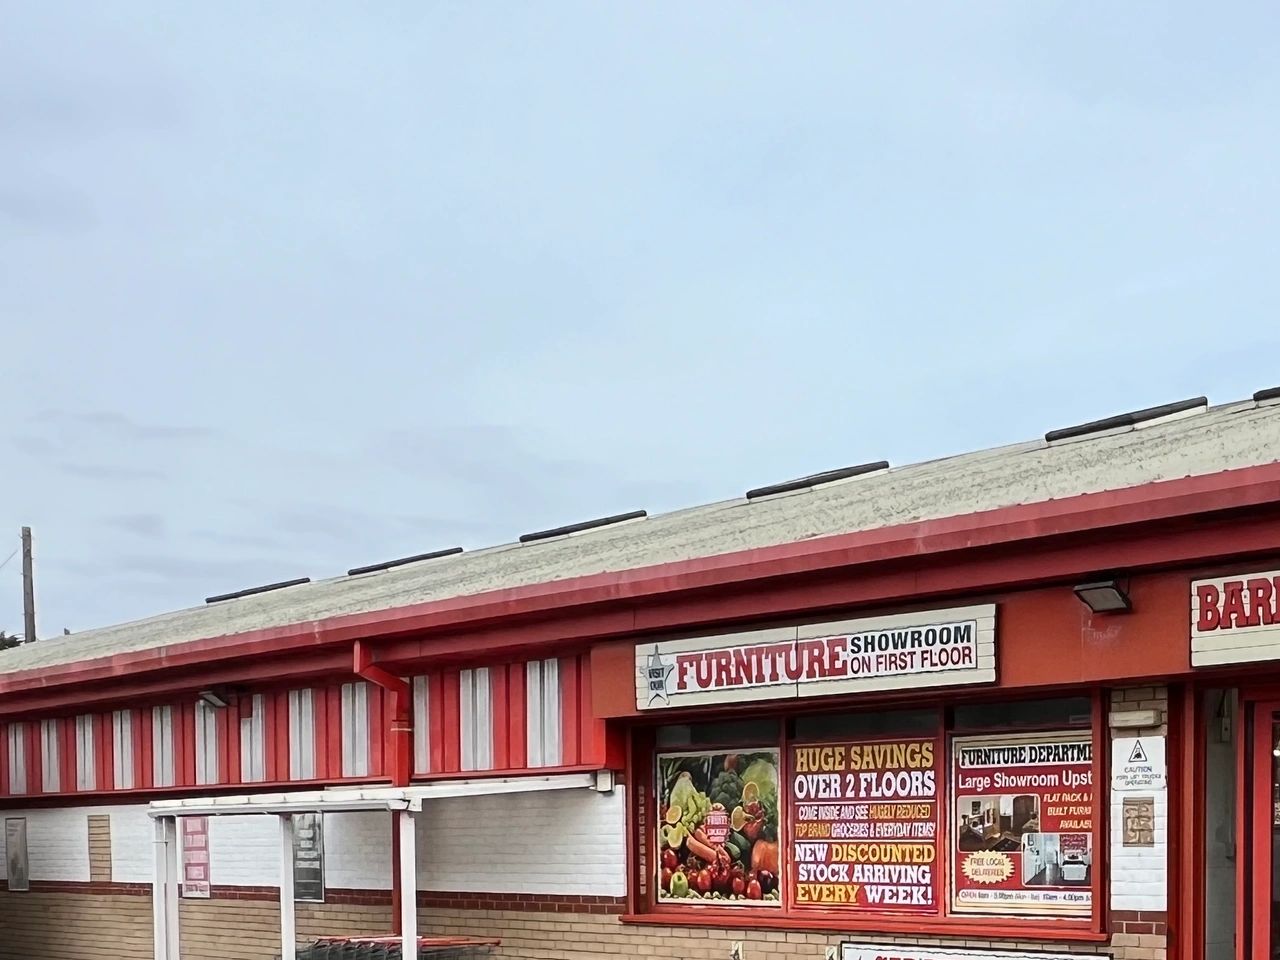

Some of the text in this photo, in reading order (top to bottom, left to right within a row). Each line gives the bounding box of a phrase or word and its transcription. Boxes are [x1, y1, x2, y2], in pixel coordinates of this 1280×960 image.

[850, 624, 972, 655] SHOWROOM
[677, 638, 848, 691] FURNITURE
[850, 646, 973, 675] ON FIRST FLOOR
[795, 742, 934, 773] HUGE SAVINGS
[960, 746, 1026, 767] FURNITURE
[1124, 766, 1153, 774] CAUTION
[794, 769, 936, 799] OVER 2 FLOORS
[958, 773, 991, 792] Large
[993, 771, 1059, 788] Showroom
[794, 843, 936, 863] NEW DISCOUNTED
[798, 863, 932, 884] STOCK ARRIVING
[796, 883, 933, 905] EVERY WEEK!
